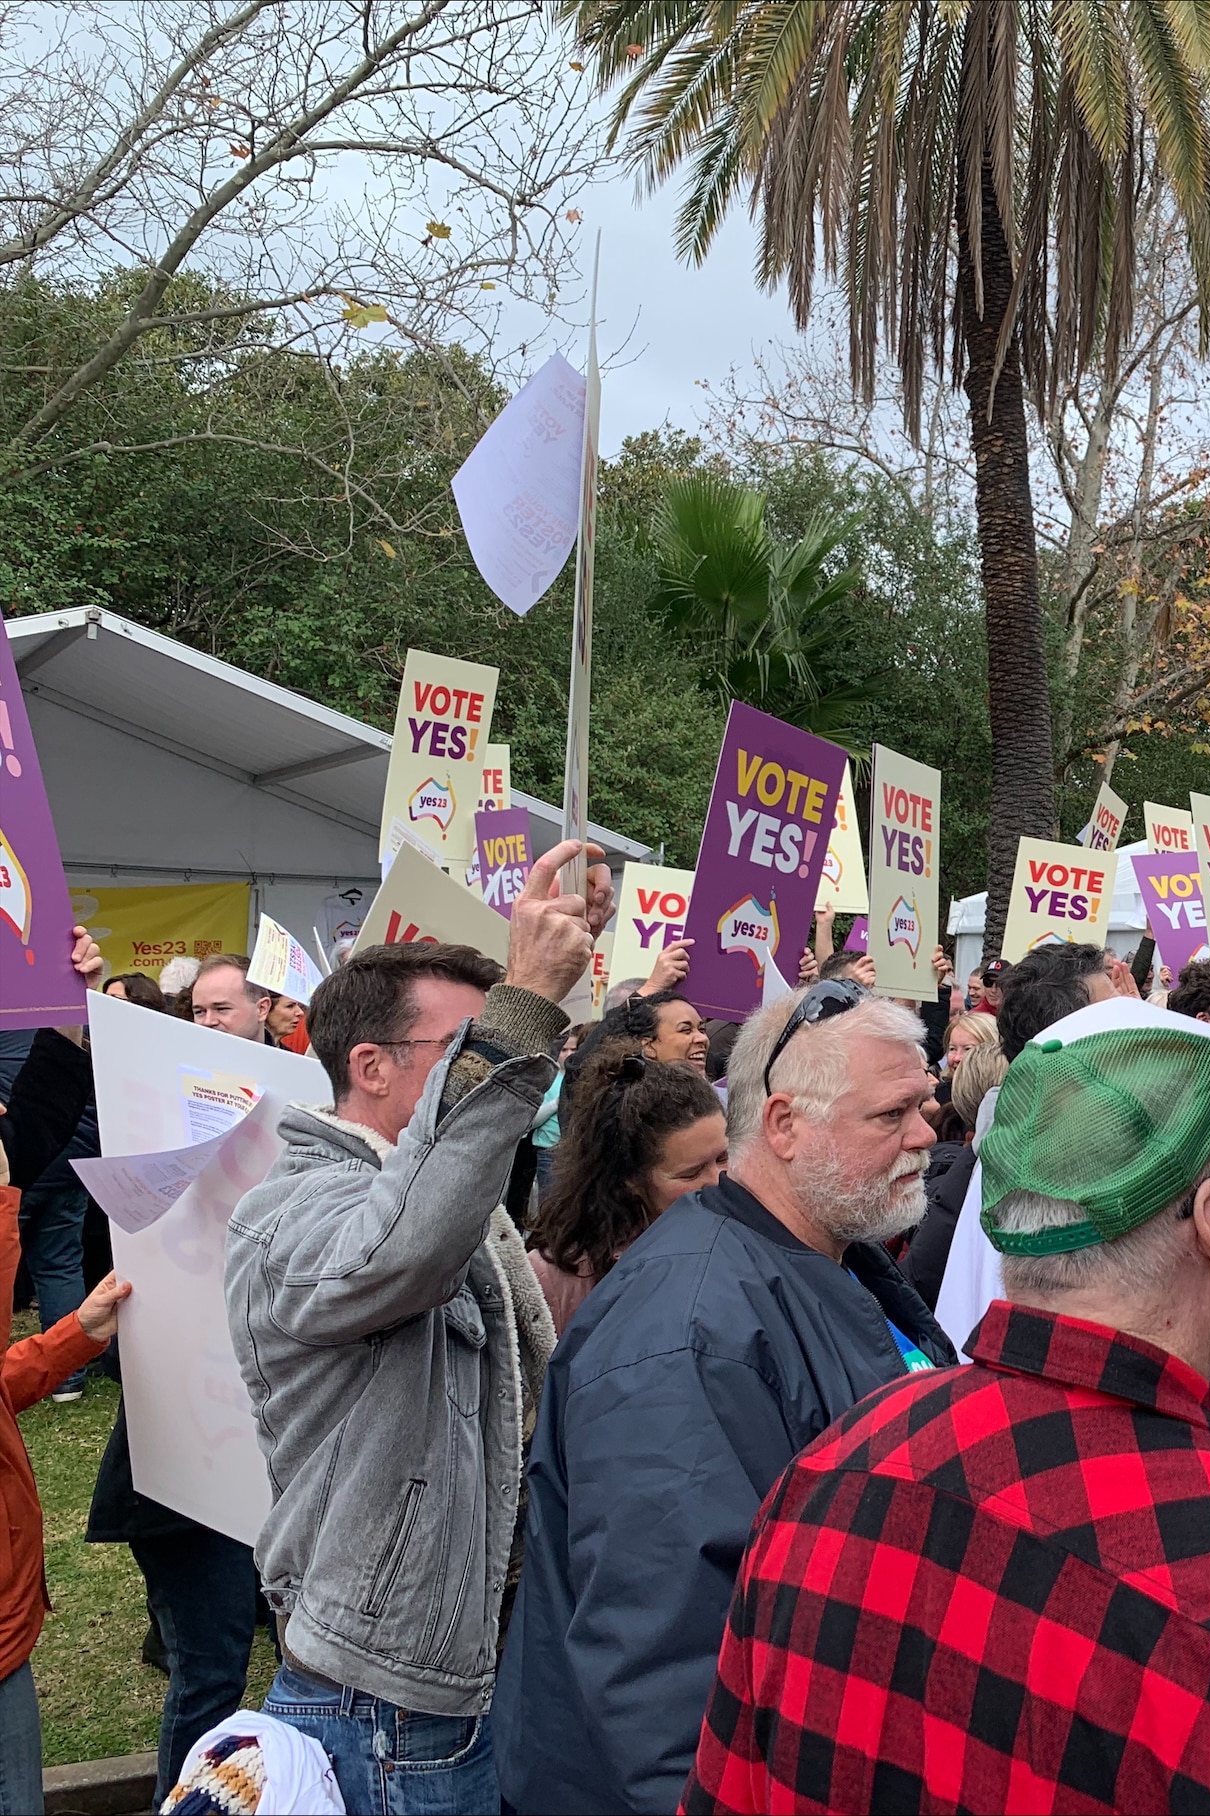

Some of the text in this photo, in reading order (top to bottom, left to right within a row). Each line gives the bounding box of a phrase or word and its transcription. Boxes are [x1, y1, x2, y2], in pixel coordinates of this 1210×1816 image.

[414, 681, 485, 723] VOTE
[408, 717, 479, 762] YES!
[482, 769, 503, 794] TE
[736, 749, 829, 825] VOTE
[419, 794, 448, 808] yes23
[882, 782, 933, 833] VOTE
[1097, 803, 1120, 838] VOTE
[483, 834, 527, 868] VOTE
[725, 800, 819, 879] YES!
[1151, 823, 1189, 850] VOTE
[880, 825, 933, 879] YES!
[1028, 860, 1105, 894] VOTE
[1148, 873, 1202, 899] VO
[637, 888, 688, 918] VO
[1024, 887, 1101, 923] YES!
[1156, 900, 1207, 930] YE
[632, 918, 684, 950] YE
[731, 918, 769, 942] yes23
[894, 916, 916, 932] yes23
[129, 958, 169, 967] .com.
[132, 941, 187, 956] Yes23
[192, 1091, 203, 1099] YES
[204, 1094, 226, 1104] POSTER
[193, 1085, 216, 1096] THANKS
